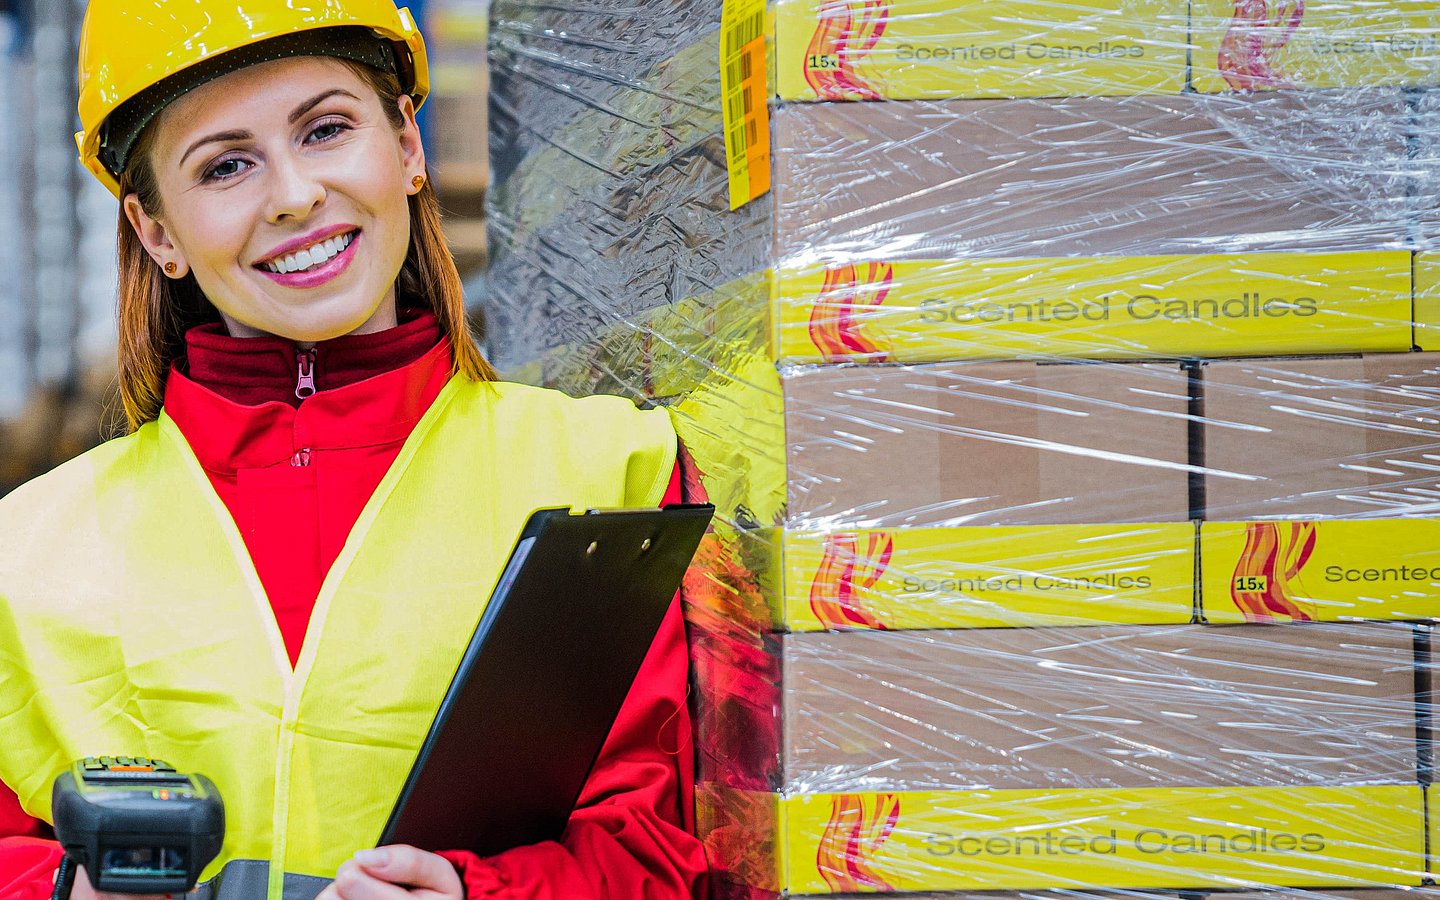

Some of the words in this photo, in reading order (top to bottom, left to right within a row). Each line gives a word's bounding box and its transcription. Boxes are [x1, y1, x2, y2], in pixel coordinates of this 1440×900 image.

[896, 43, 1015, 61] Scented
[1026, 42, 1144, 60] Candles
[809, 54, 837, 69] 15x
[919, 297, 1110, 323] Scented
[1126, 293, 1318, 320] Candles
[902, 575, 1022, 592] Scented
[1033, 573, 1152, 591] Candles
[1236, 578, 1265, 591] 15x
[926, 829, 1116, 855] Scented
[1134, 828, 1326, 853] Candles
